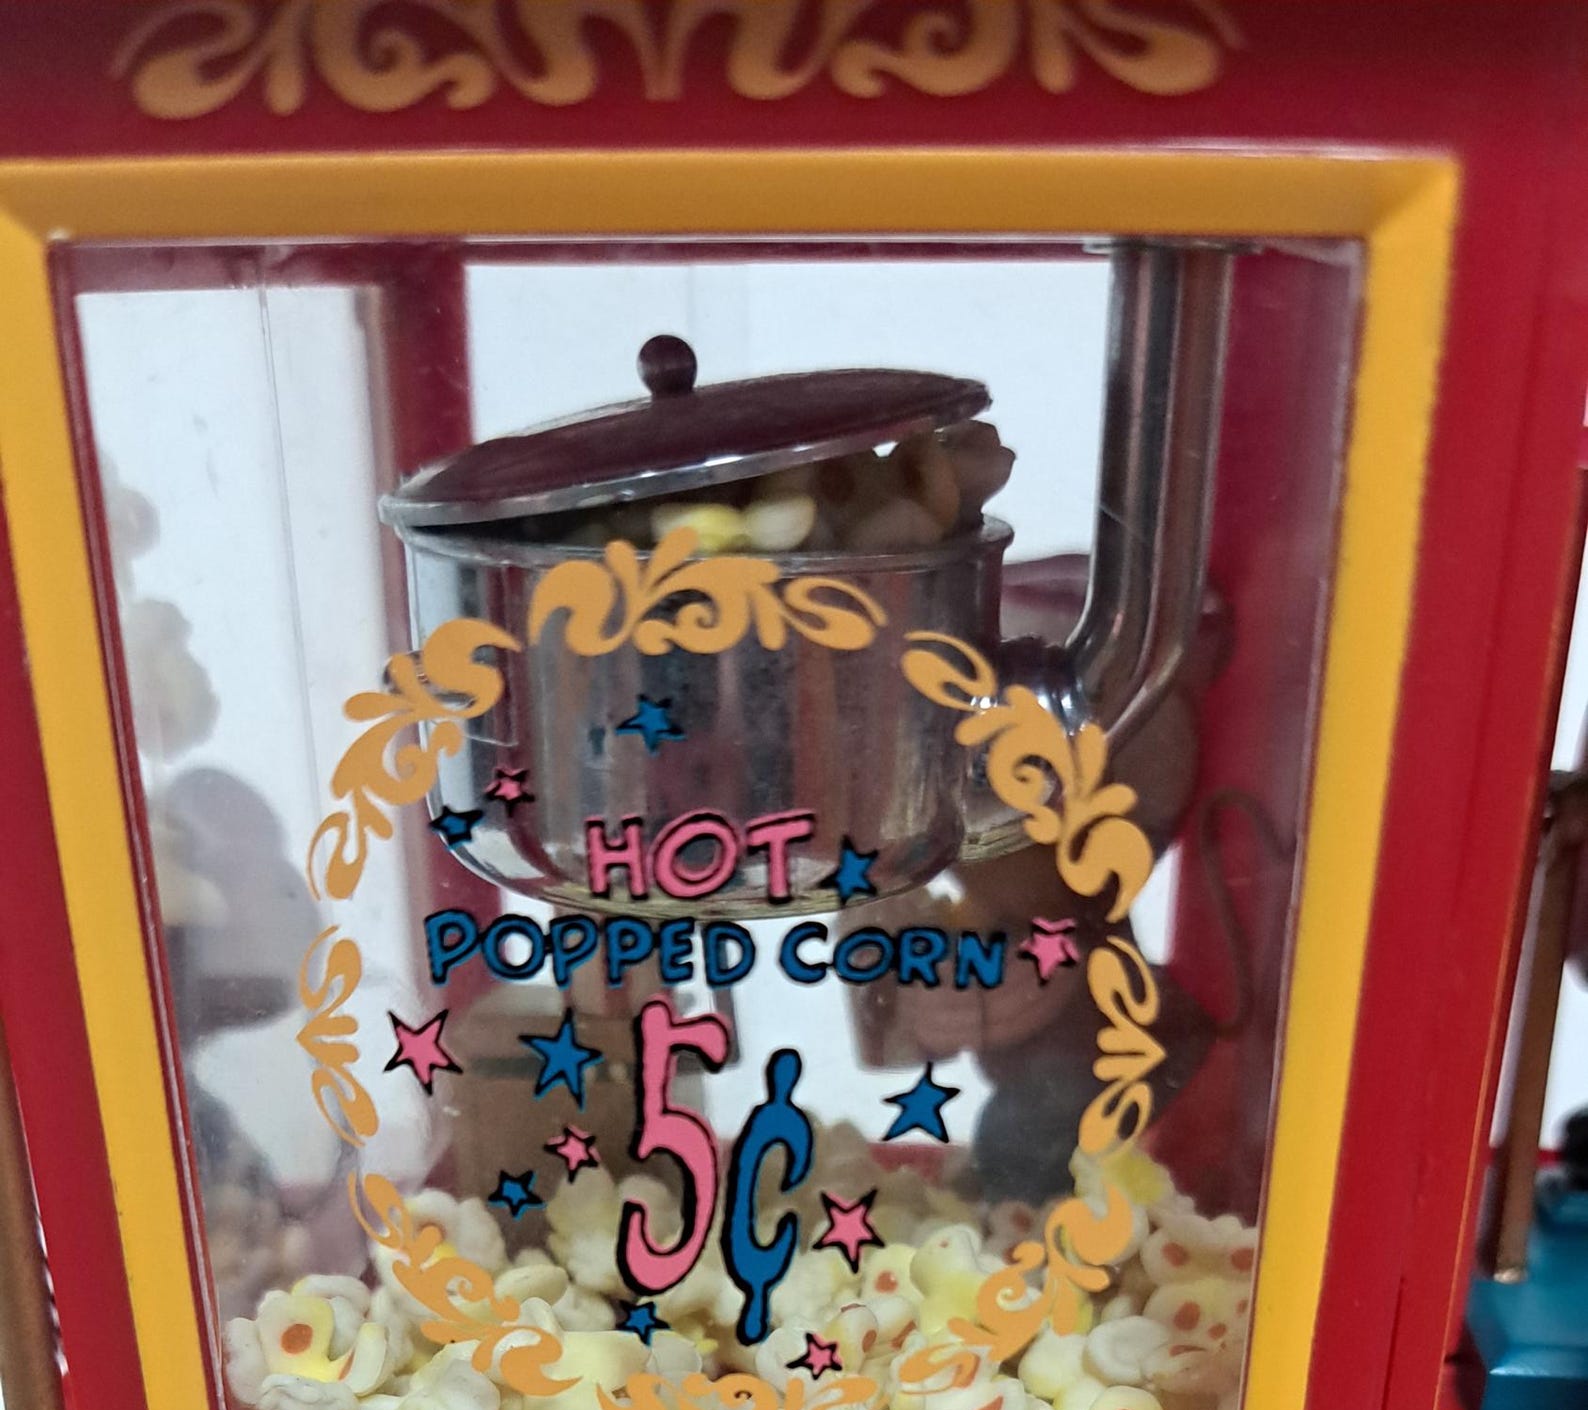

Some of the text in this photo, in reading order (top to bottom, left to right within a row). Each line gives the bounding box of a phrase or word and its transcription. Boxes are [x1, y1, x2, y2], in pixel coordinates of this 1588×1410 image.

[585, 811, 818, 902] HOT
[425, 910, 1006, 988] POPPED CORN
[617, 1000, 815, 1346] 5¢
